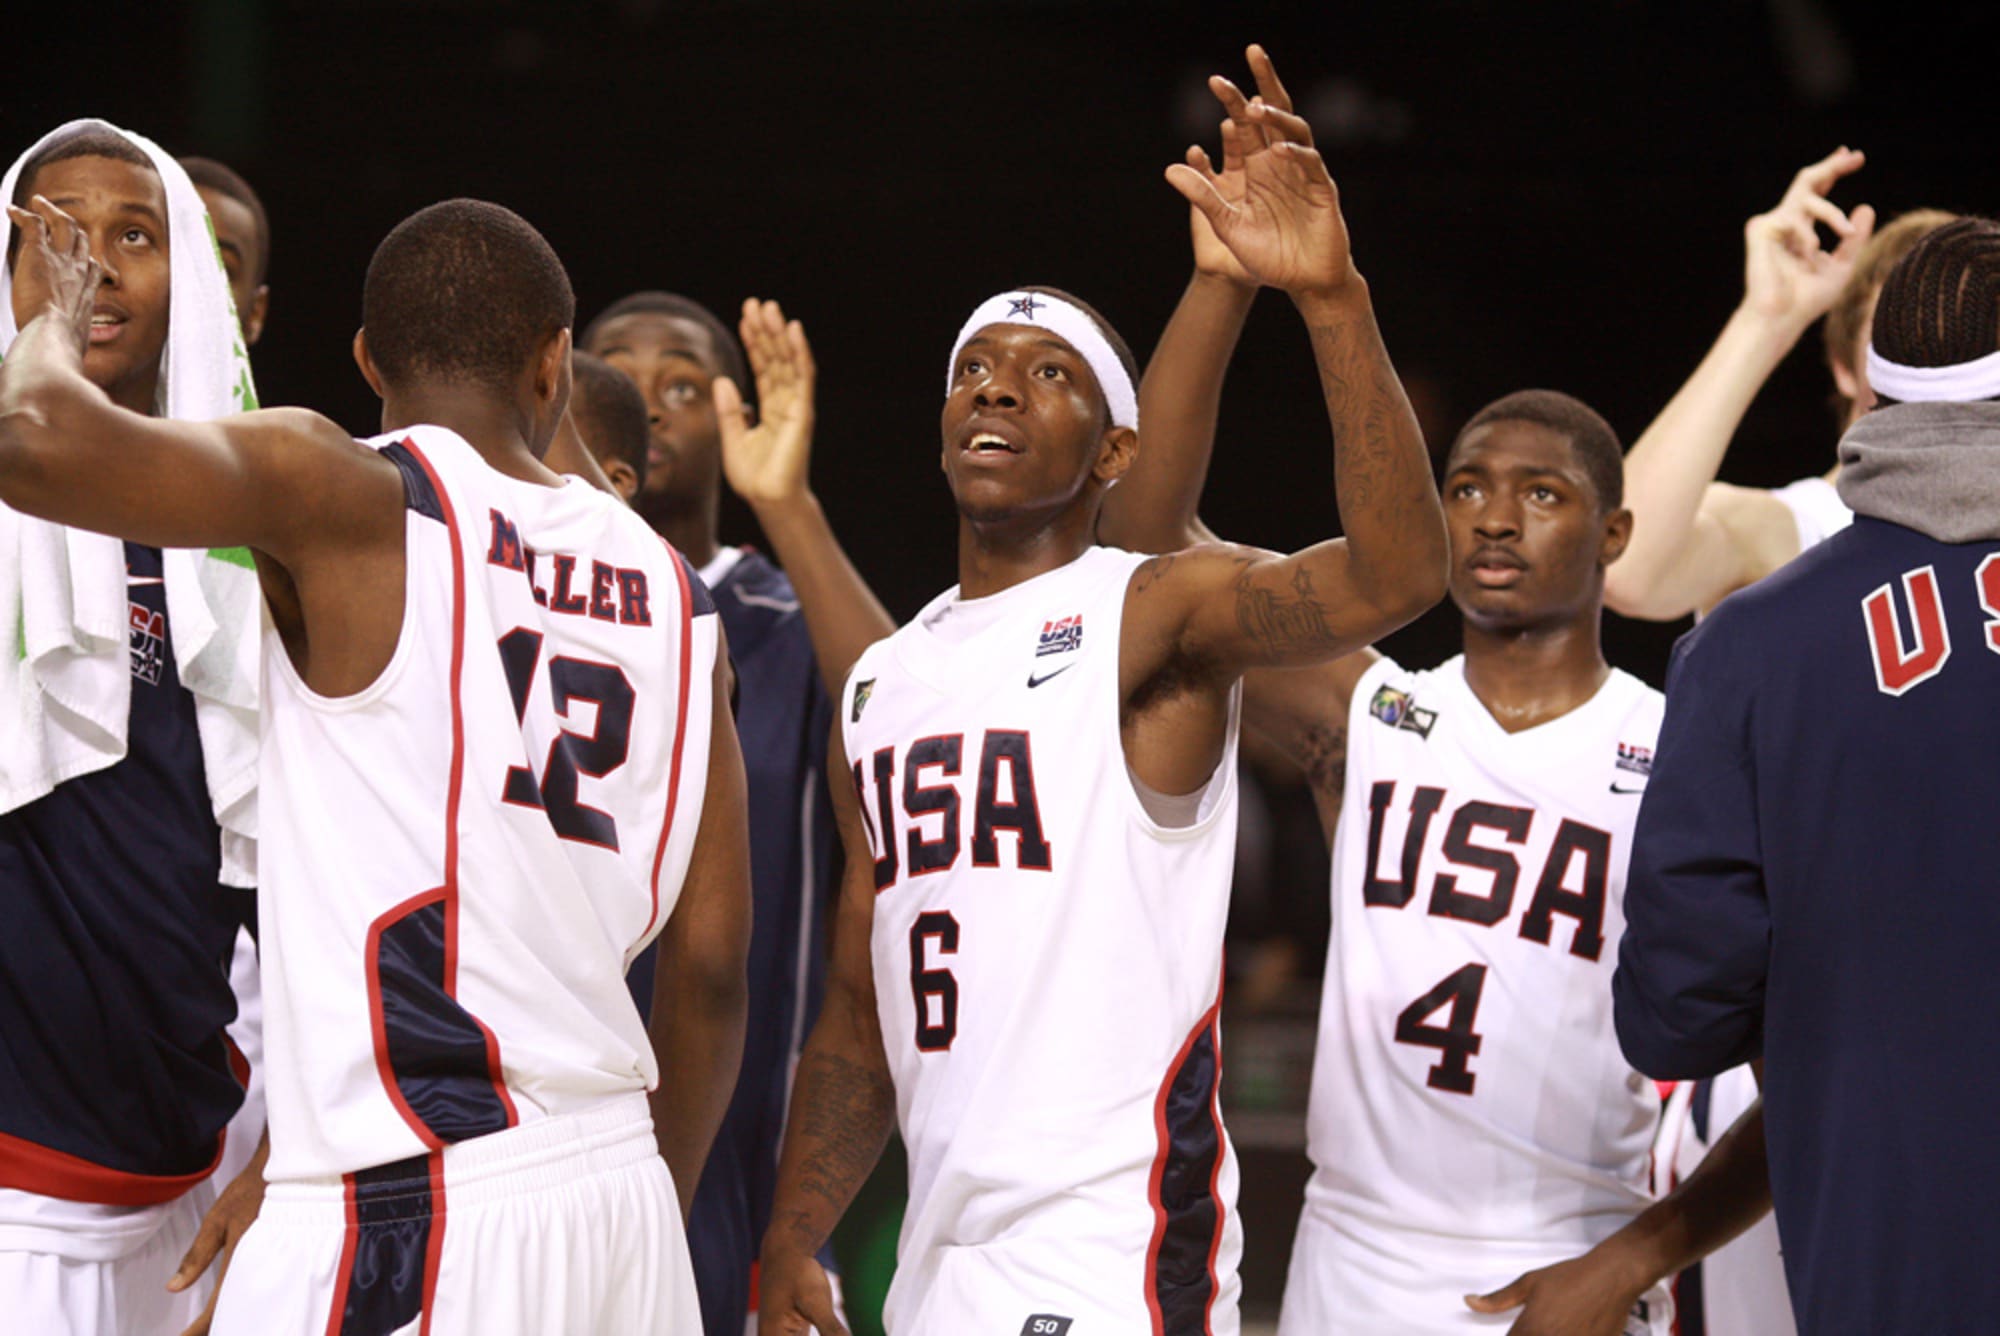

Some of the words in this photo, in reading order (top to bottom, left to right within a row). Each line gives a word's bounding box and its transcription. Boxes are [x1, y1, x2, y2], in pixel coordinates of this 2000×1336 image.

[487, 507, 653, 627] MLLER
[1039, 613, 1082, 643] USA
[128, 601, 165, 662] SA
[497, 625, 637, 854] 12
[1617, 742, 1651, 764] US
[853, 728, 1053, 895] USA
[1363, 780, 1612, 963] USA
[909, 909, 961, 1053] 6
[1394, 962, 1489, 1097] 4
[1032, 1318, 1059, 1335] 50
